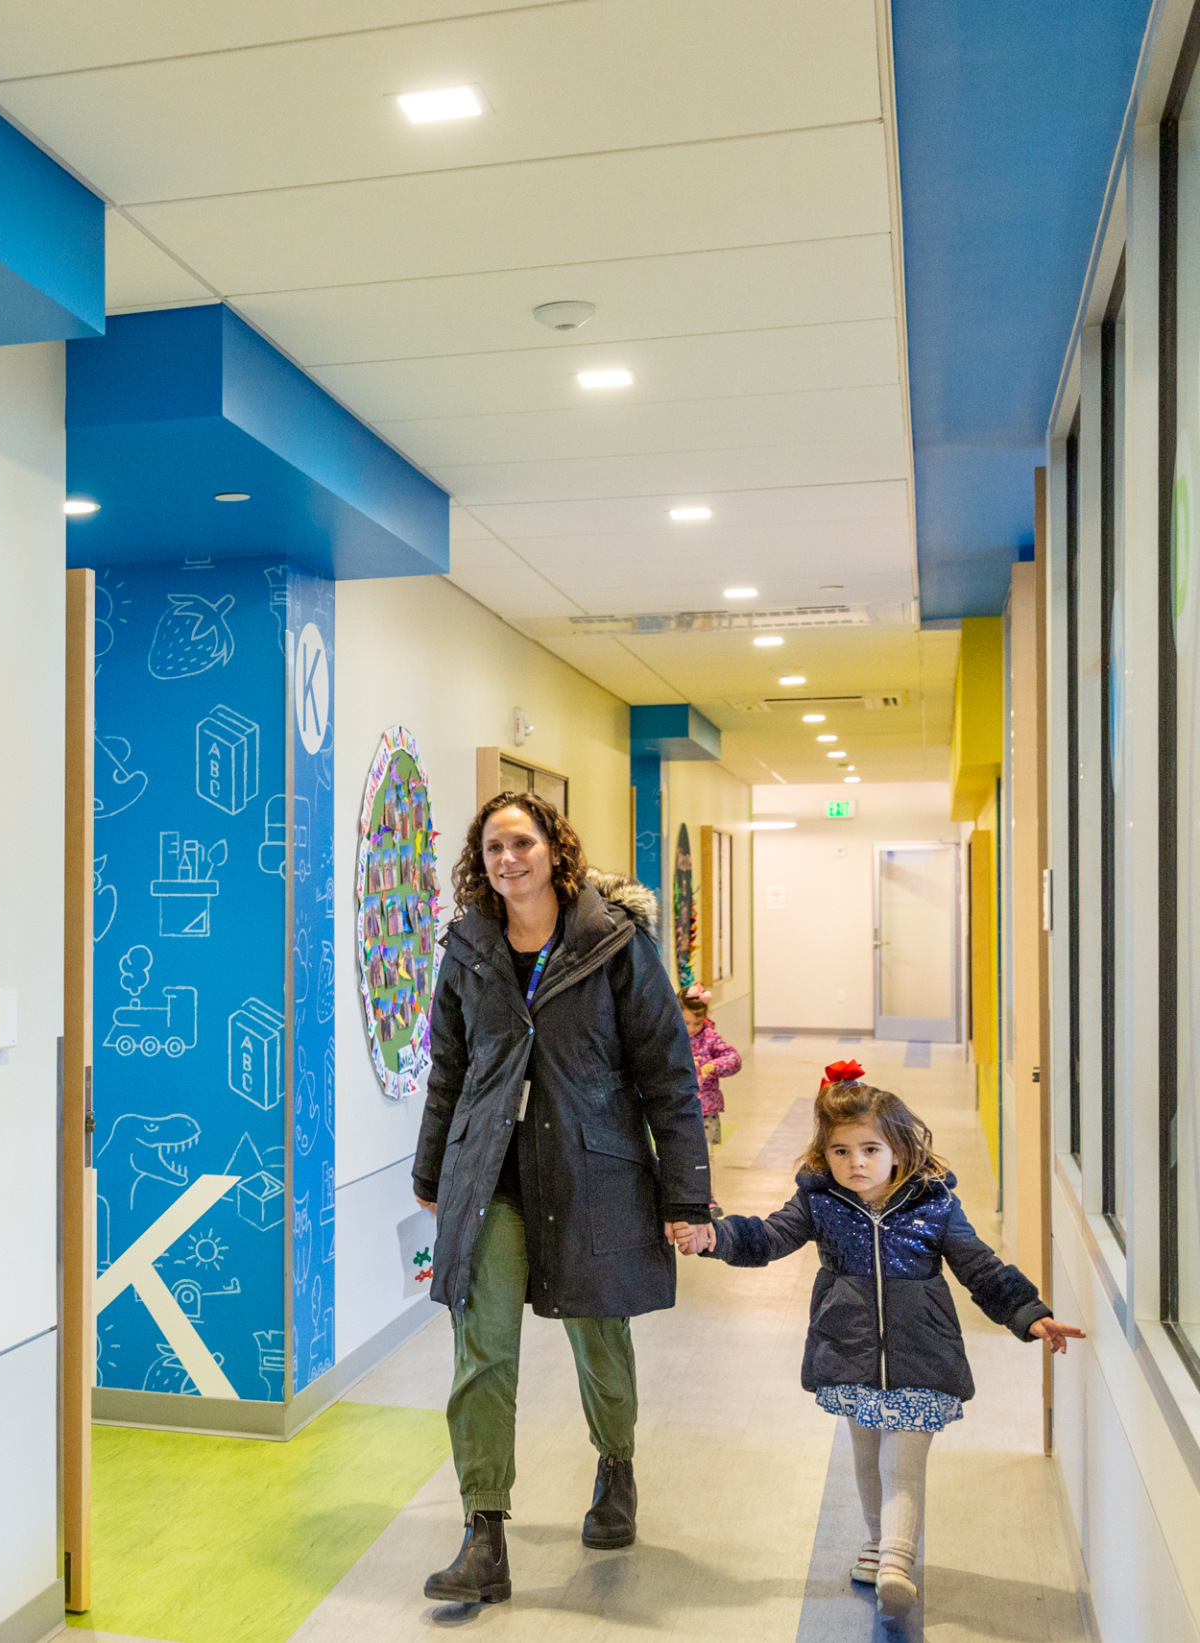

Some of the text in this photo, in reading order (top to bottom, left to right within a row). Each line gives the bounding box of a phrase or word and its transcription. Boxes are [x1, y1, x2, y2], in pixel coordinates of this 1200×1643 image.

[303, 642, 321, 737] K
[208, 742, 220, 798] ABC
[240, 1036, 253, 1092] ABC
[92, 1168, 242, 1400] K
